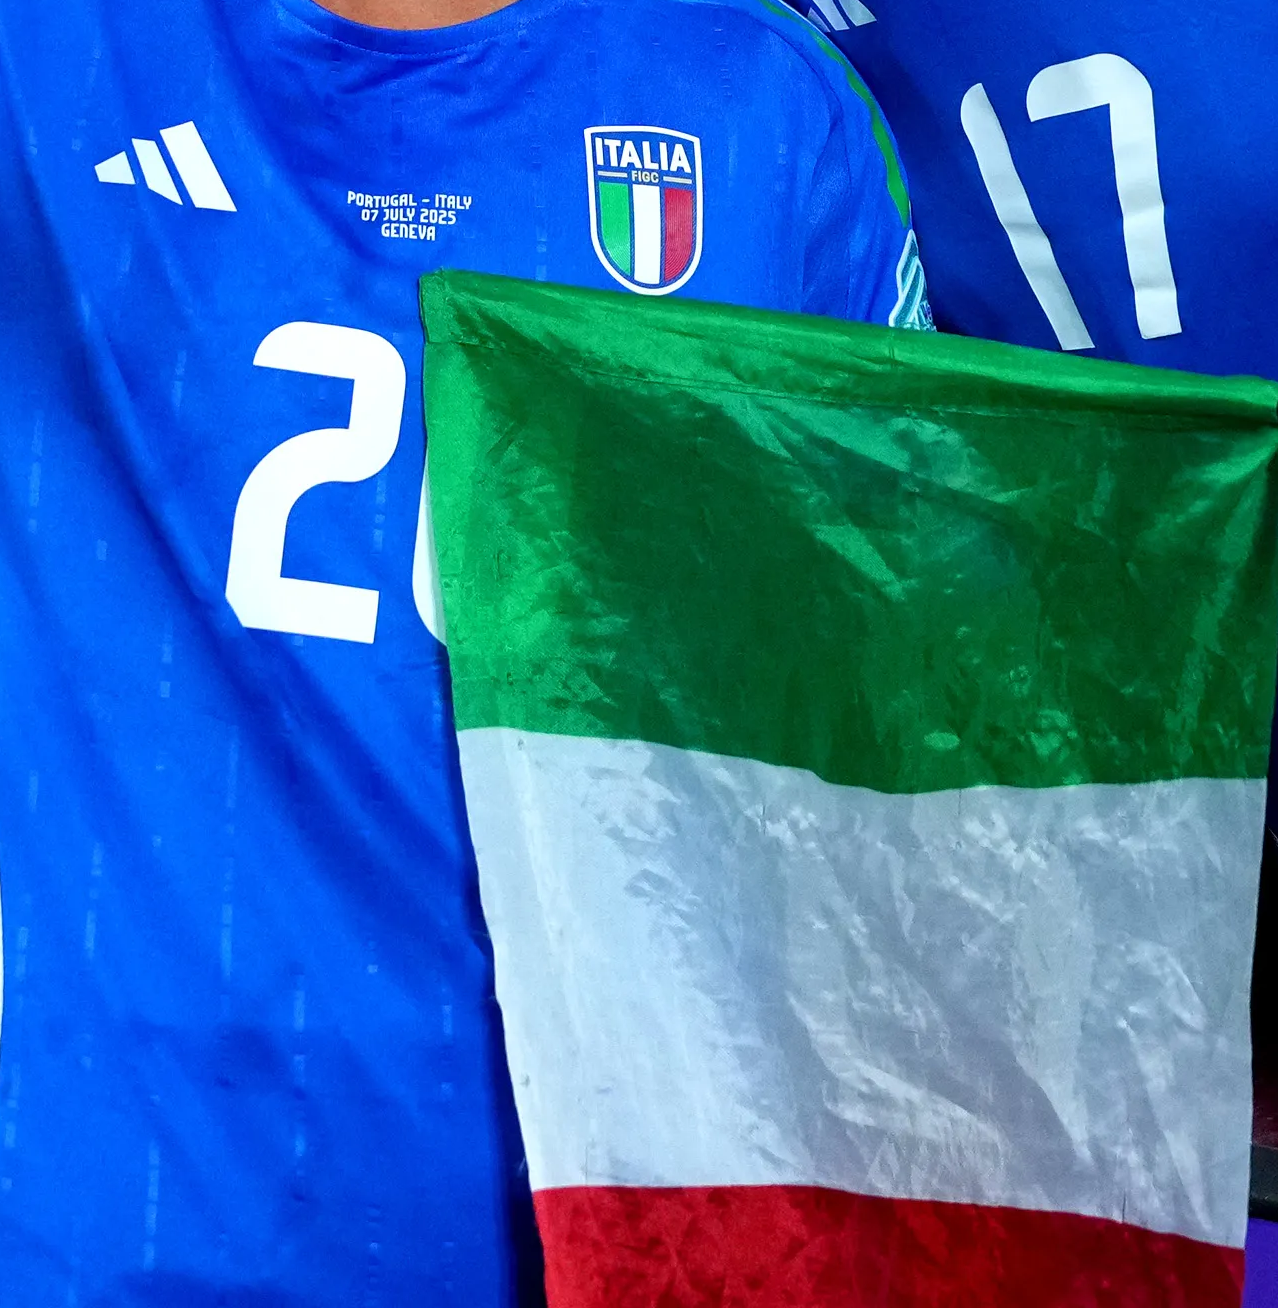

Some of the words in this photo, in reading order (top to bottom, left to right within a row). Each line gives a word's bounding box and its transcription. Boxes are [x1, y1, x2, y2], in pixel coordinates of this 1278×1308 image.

[595, 137, 693, 175] ITALIA
[631, 169, 660, 184] FIGC
[347, 190, 418, 209] PORTUGAL
[434, 192, 472, 210] ITALY
[960, 53, 1182, 351] 17
[361, 208, 379, 223] 07
[382, 207, 415, 223] JULY
[419, 208, 457, 225] 2025
[381, 222, 436, 241] GENEVA
[225, 321, 449, 647] 2
